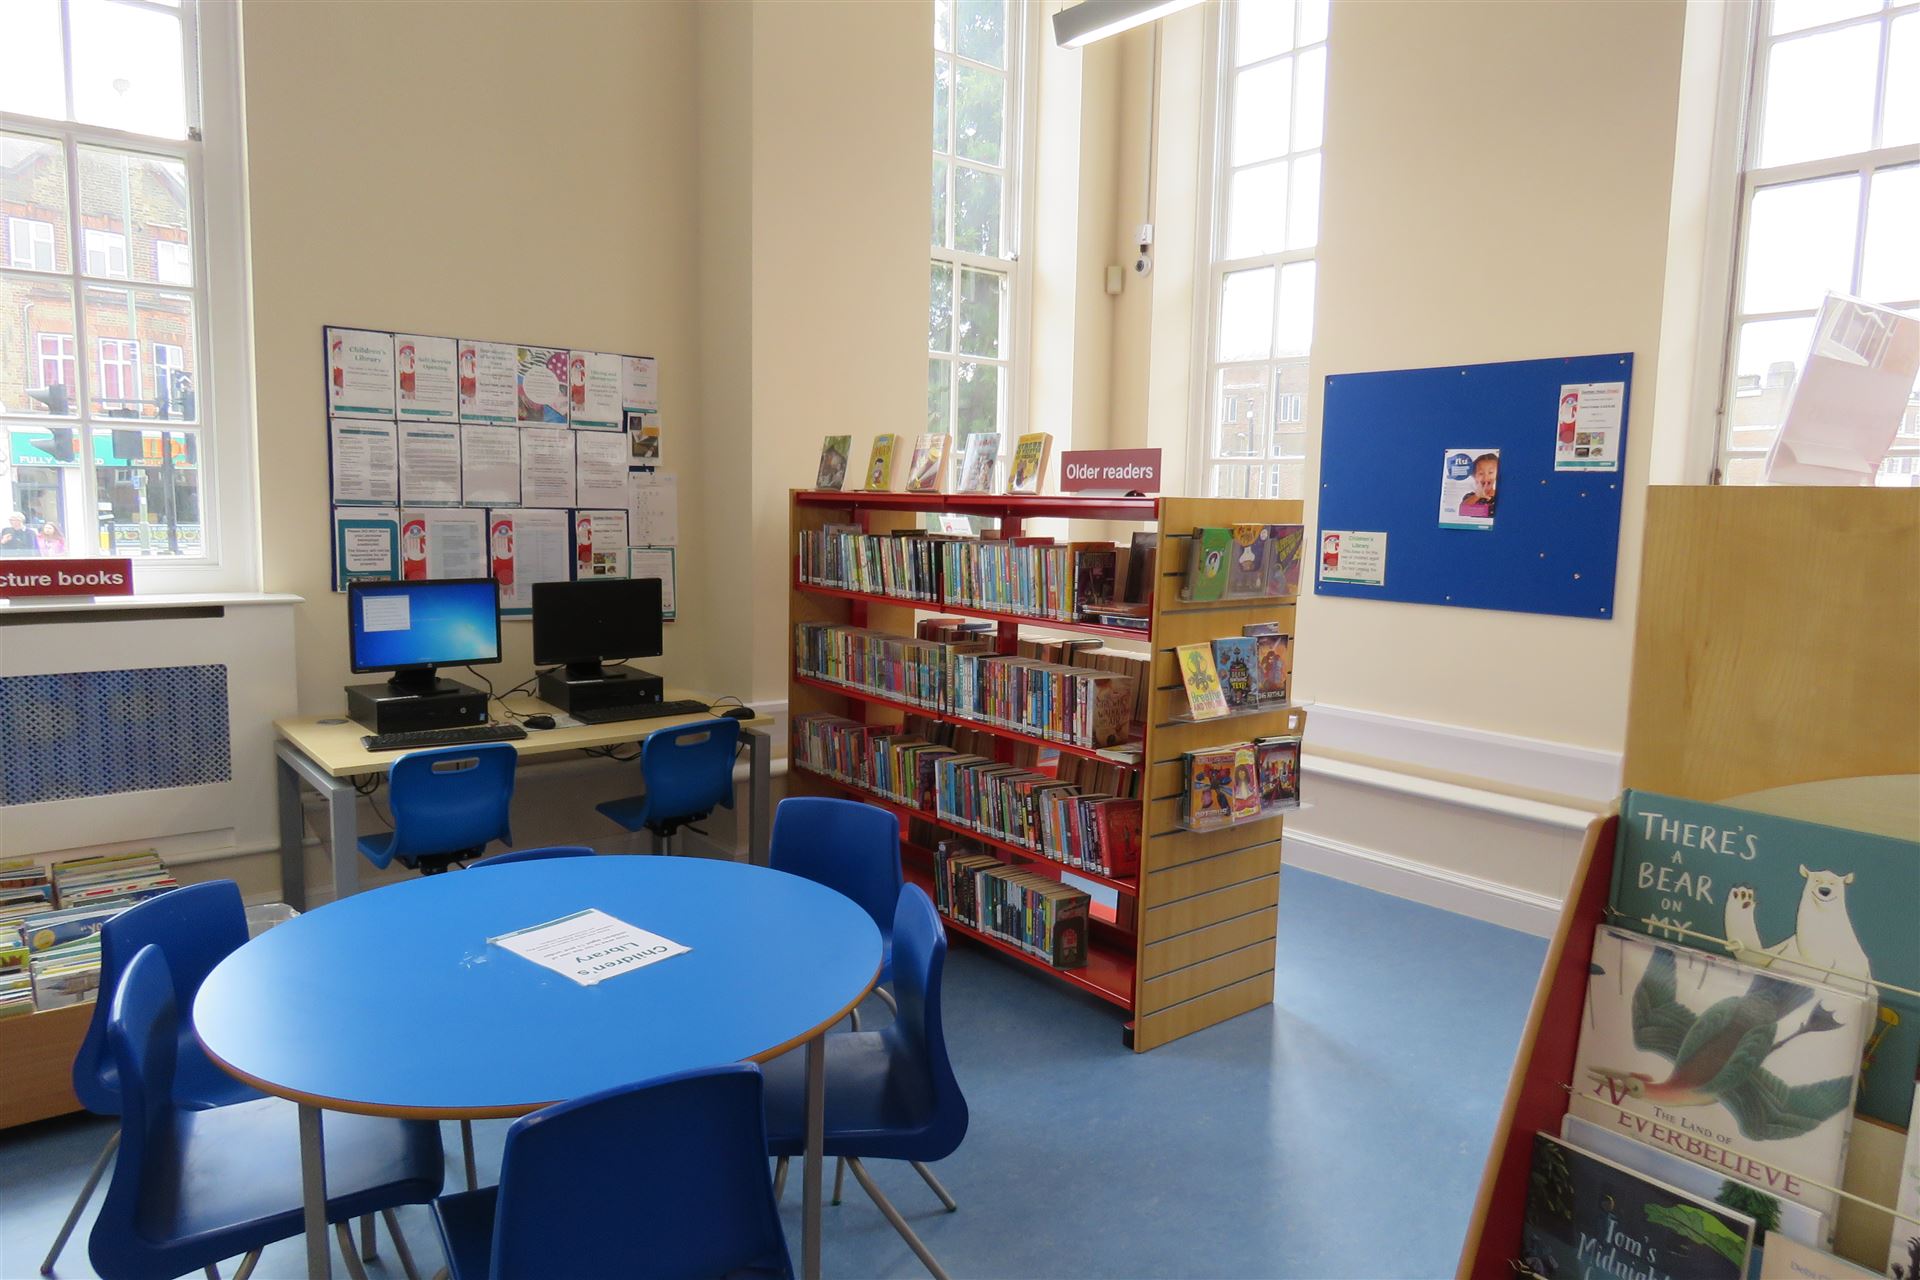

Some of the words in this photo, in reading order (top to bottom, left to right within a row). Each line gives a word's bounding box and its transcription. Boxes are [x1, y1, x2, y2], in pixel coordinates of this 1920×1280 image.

[19, 455, 53, 464] FULLY
[1066, 463, 1100, 480] Older
[1103, 463, 1153, 479] readers
[58, 571, 124, 586] books
[1638, 811, 1758, 860] THERE'S
[1671, 850, 1683, 865] A
[1638, 862, 1714, 905] BEAR
[1661, 898, 1683, 913] ON
[1648, 913, 1693, 942] MY
[575, 942, 639, 963] Library
[577, 945, 668, 976] Children's
[1604, 1218, 1657, 1263] Tom's
[1577, 1231, 1671, 1280] Midnih
